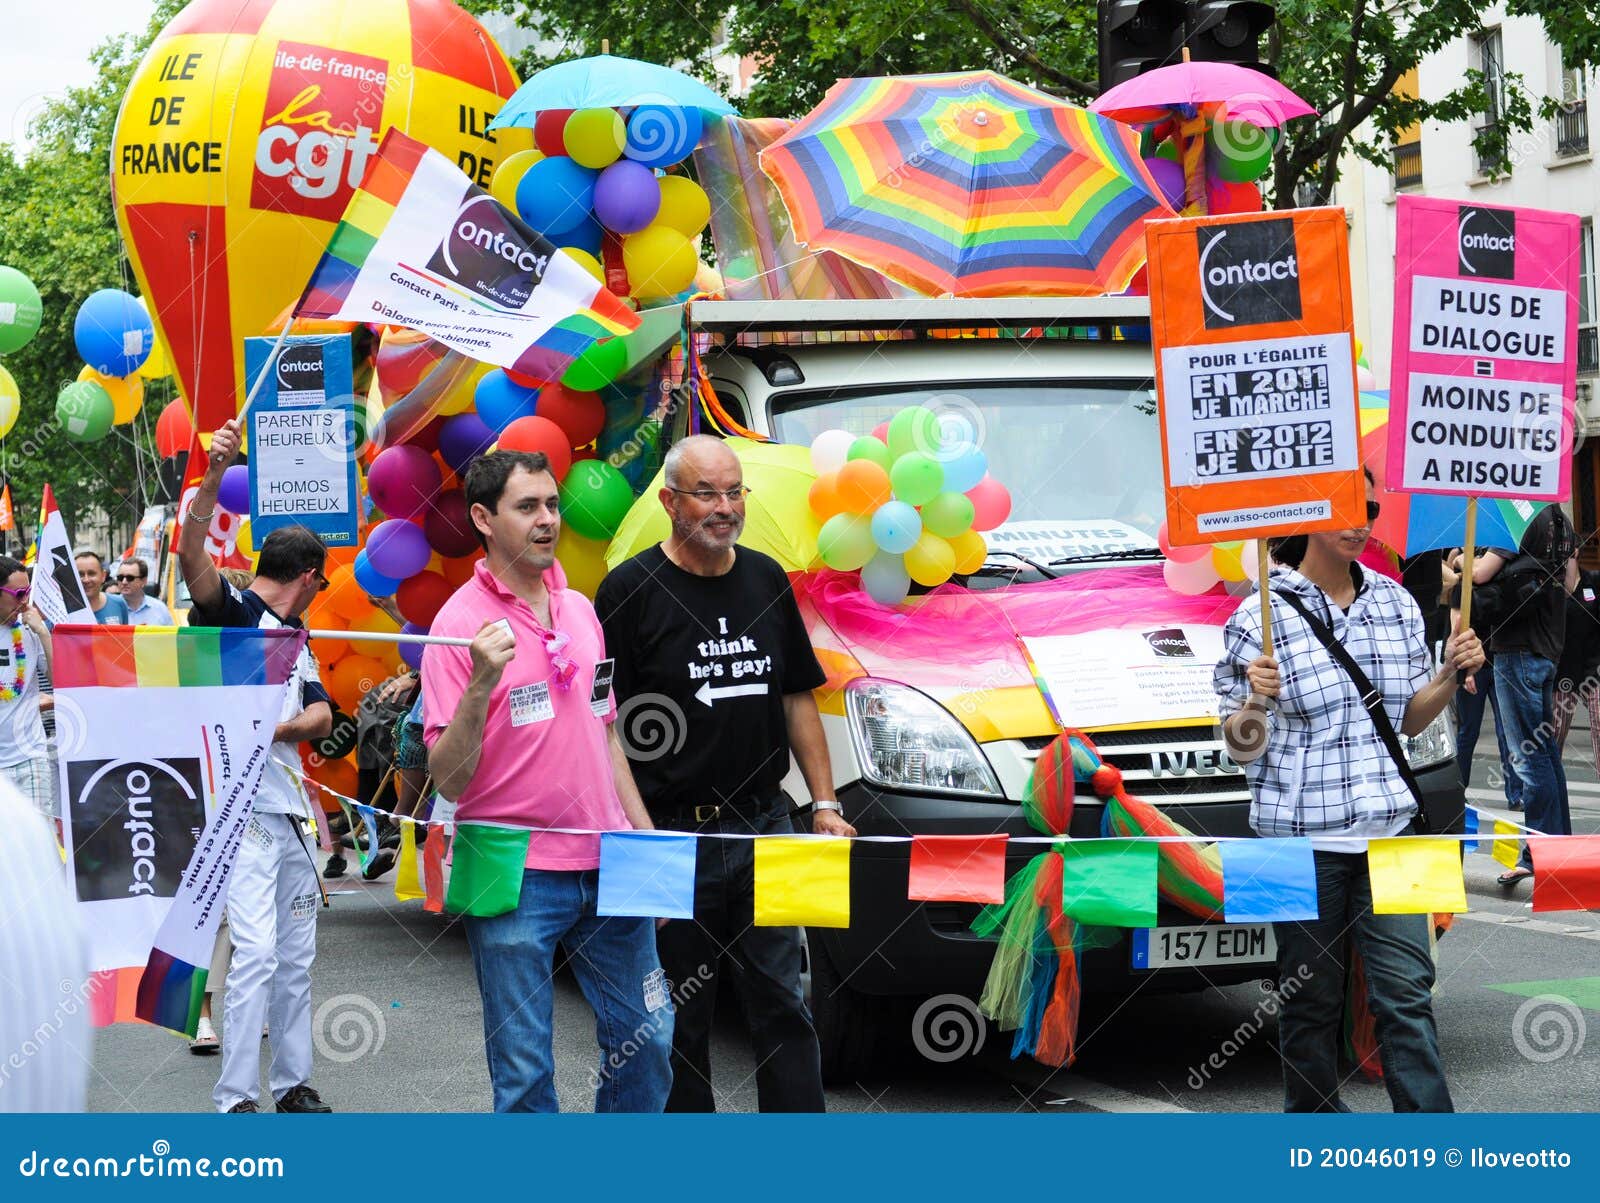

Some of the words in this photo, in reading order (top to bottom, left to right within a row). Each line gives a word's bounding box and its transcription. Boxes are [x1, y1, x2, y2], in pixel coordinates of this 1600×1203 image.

[159, 53, 202, 81] ILE
[274, 50, 388, 86] ile-de-france
[149, 97, 185, 126] DE
[266, 85, 352, 137] la
[459, 104, 497, 144] ILE
[122, 141, 222, 176] FRANCE
[255, 125, 379, 199] cgt
[458, 150, 493, 189] DE
[390, 271, 432, 298] Contact
[432, 293, 459, 311] Paris
[511, 287, 530, 299] Paris
[1439, 288, 1501, 316] PLUS
[1511, 293, 1541, 320] DE
[371, 300, 424, 326] Dialogue
[1422, 323, 1555, 358] DIALOGUE
[1189, 354, 1236, 369] POUR
[1244, 344, 1327, 365] L'ÉGALITÉ
[1192, 373, 1238, 398] EN
[1251, 365, 1327, 393] 2011
[1193, 398, 1221, 419] JE
[1229, 389, 1329, 416] MARCHE
[1422, 385, 1510, 414] MOINS
[1519, 391, 1550, 416] DE
[258, 413, 333, 428] PARENTS
[258, 432, 336, 446] HEUREUX
[1196, 430, 1239, 454] EN
[1252, 422, 1331, 449] 2012
[1411, 421, 1557, 453] CONDUITES
[1197, 452, 1237, 475] JE
[1250, 444, 1332, 471] VOTE
[1422, 459, 1441, 481] A
[1450, 461, 1541, 488] RISQUE
[270, 480, 330, 494] HOMOS
[262, 497, 339, 512] HEUREUX
[1203, 504, 1324, 526] www.asso-contact.org
[991, 529, 1129, 542] MINUTES
[1015, 543, 1137, 560] SILENCE
[717, 617, 729, 634] I
[697, 635, 757, 657] think
[688, 661, 724, 679] he's
[731, 655, 772, 678] gay!
[241, 744, 265, 779] leurs
[1150, 750, 1245, 778] IVEC
[212, 781, 245, 835] familles
[241, 799, 254, 815] et
[203, 838, 215, 854] et
[184, 856, 209, 890] amis
[194, 863, 231, 931] parents,
[1138, 953, 1144, 961] F
[1160, 930, 1208, 961] 157
[1216, 927, 1266, 959] EDM
